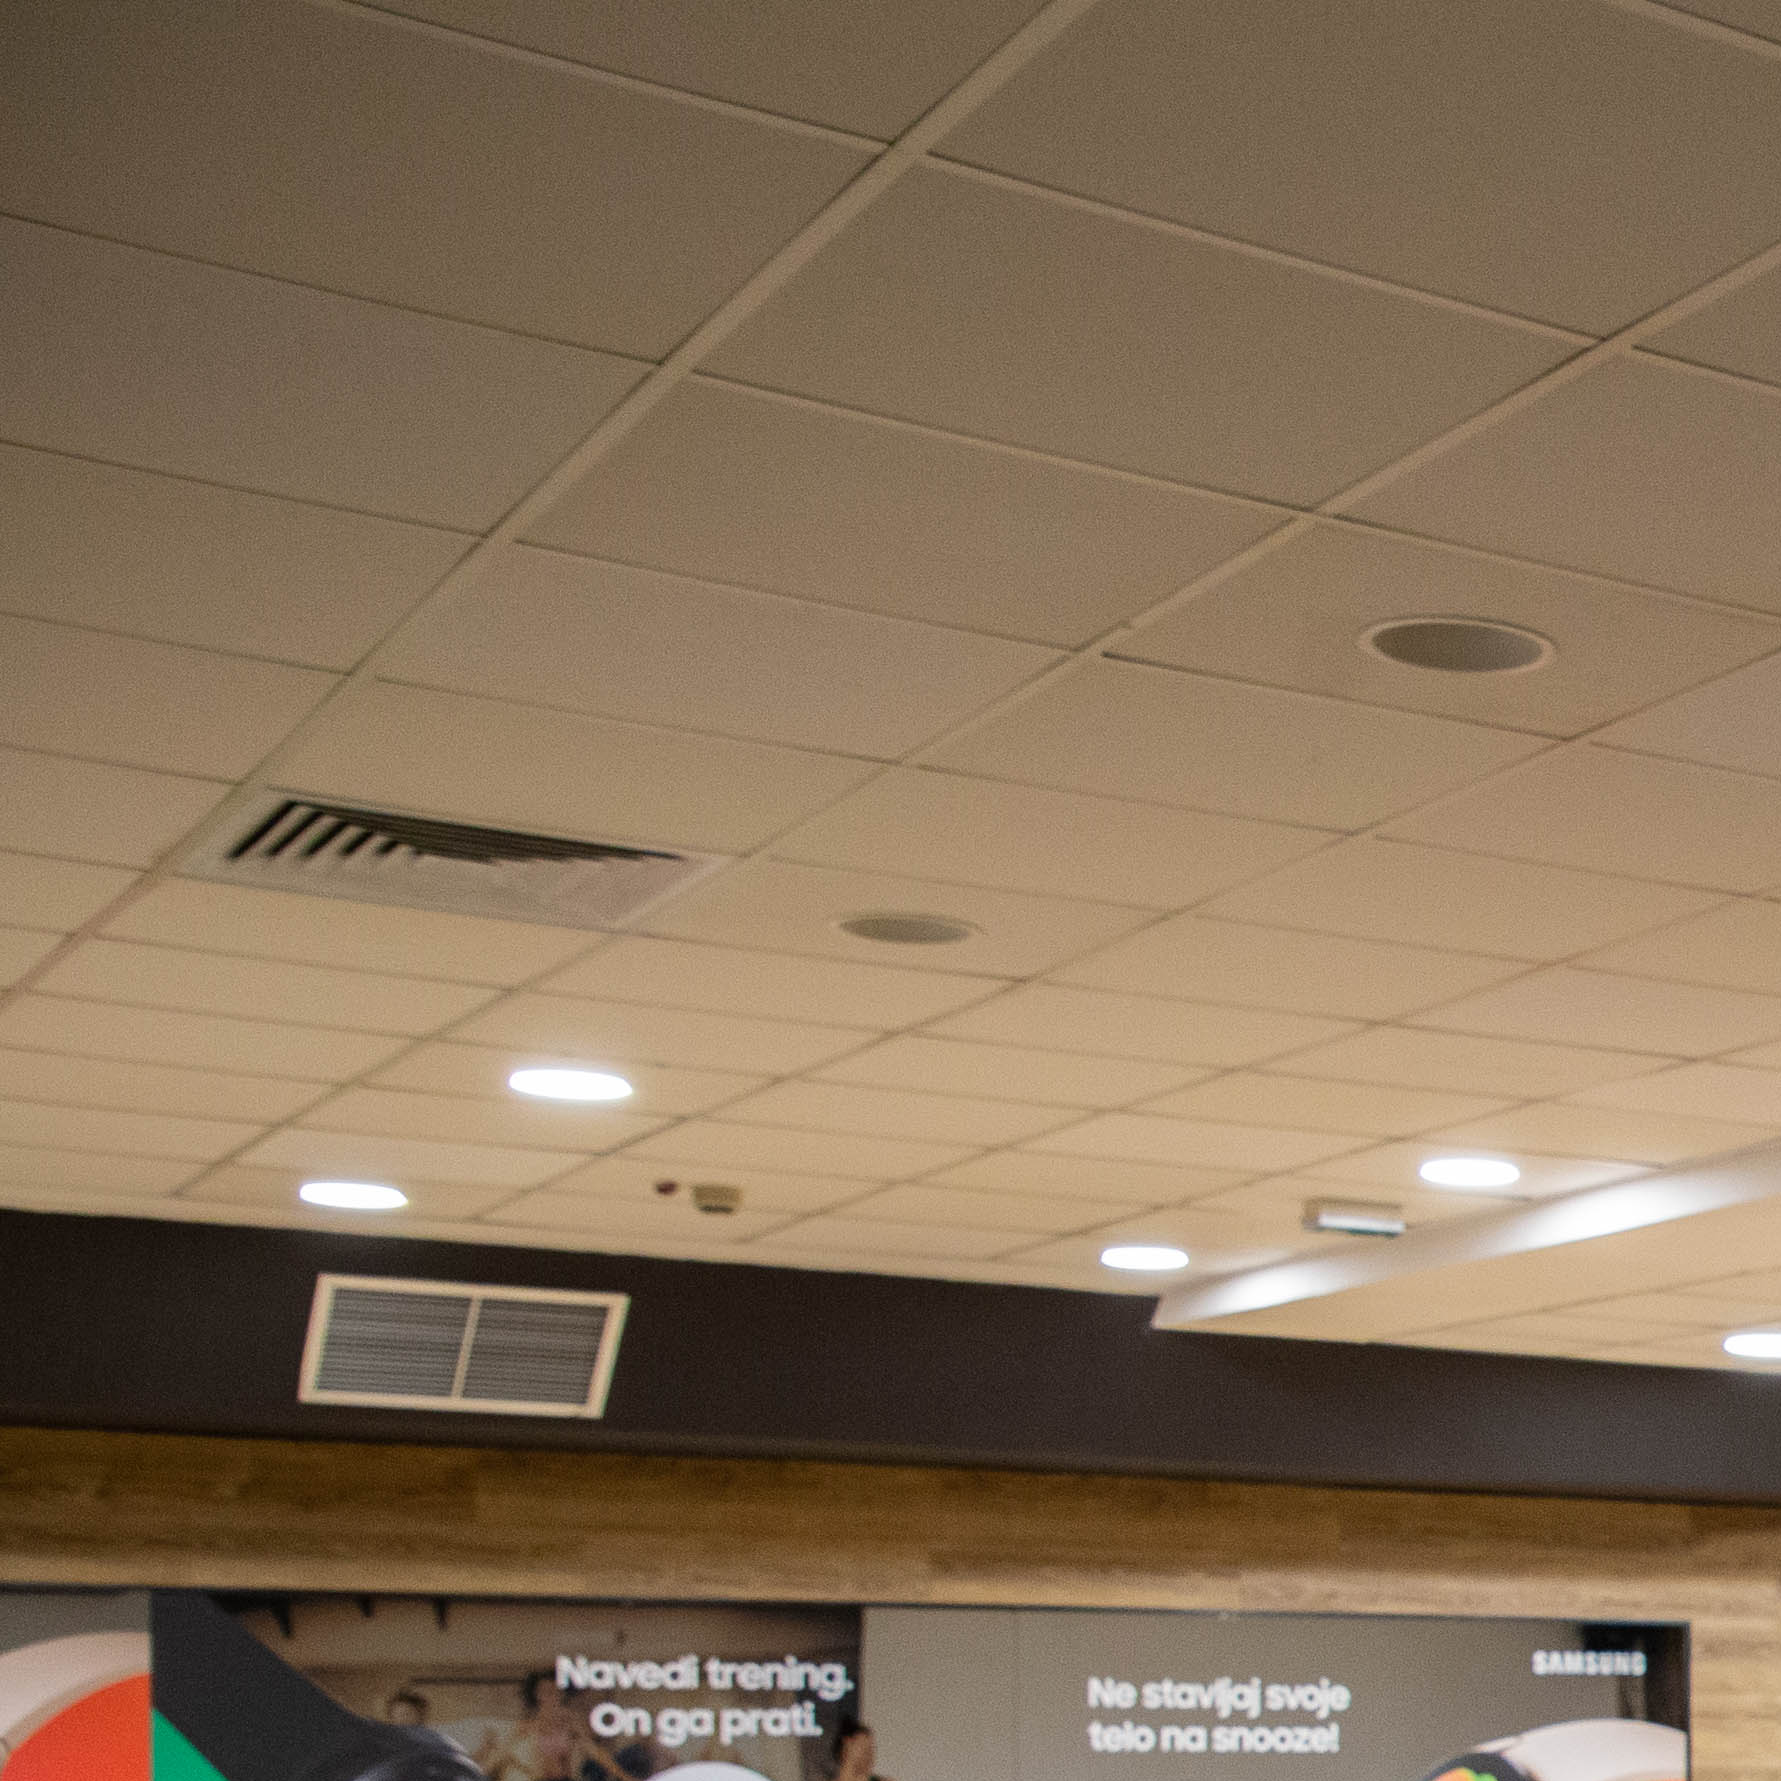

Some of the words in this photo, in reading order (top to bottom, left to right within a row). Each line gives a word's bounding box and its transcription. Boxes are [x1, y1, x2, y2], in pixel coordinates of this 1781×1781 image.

[555, 1654, 699, 1690] Navedi
[704, 1653, 855, 1702] trening.
[1531, 1649, 1647, 1677] SAMSUNG
[1087, 1676, 1138, 1709] Ne
[1141, 1676, 1262, 1719] stavljaj
[1264, 1676, 1351, 1720] svoje
[589, 1701, 652, 1737] On
[655, 1707, 716, 1748] ga
[719, 1700, 824, 1746] prati.
[1087, 1719, 1157, 1752] telo
[1159, 1724, 1209, 1753] na
[1211, 1721, 1340, 1754] snooze!
